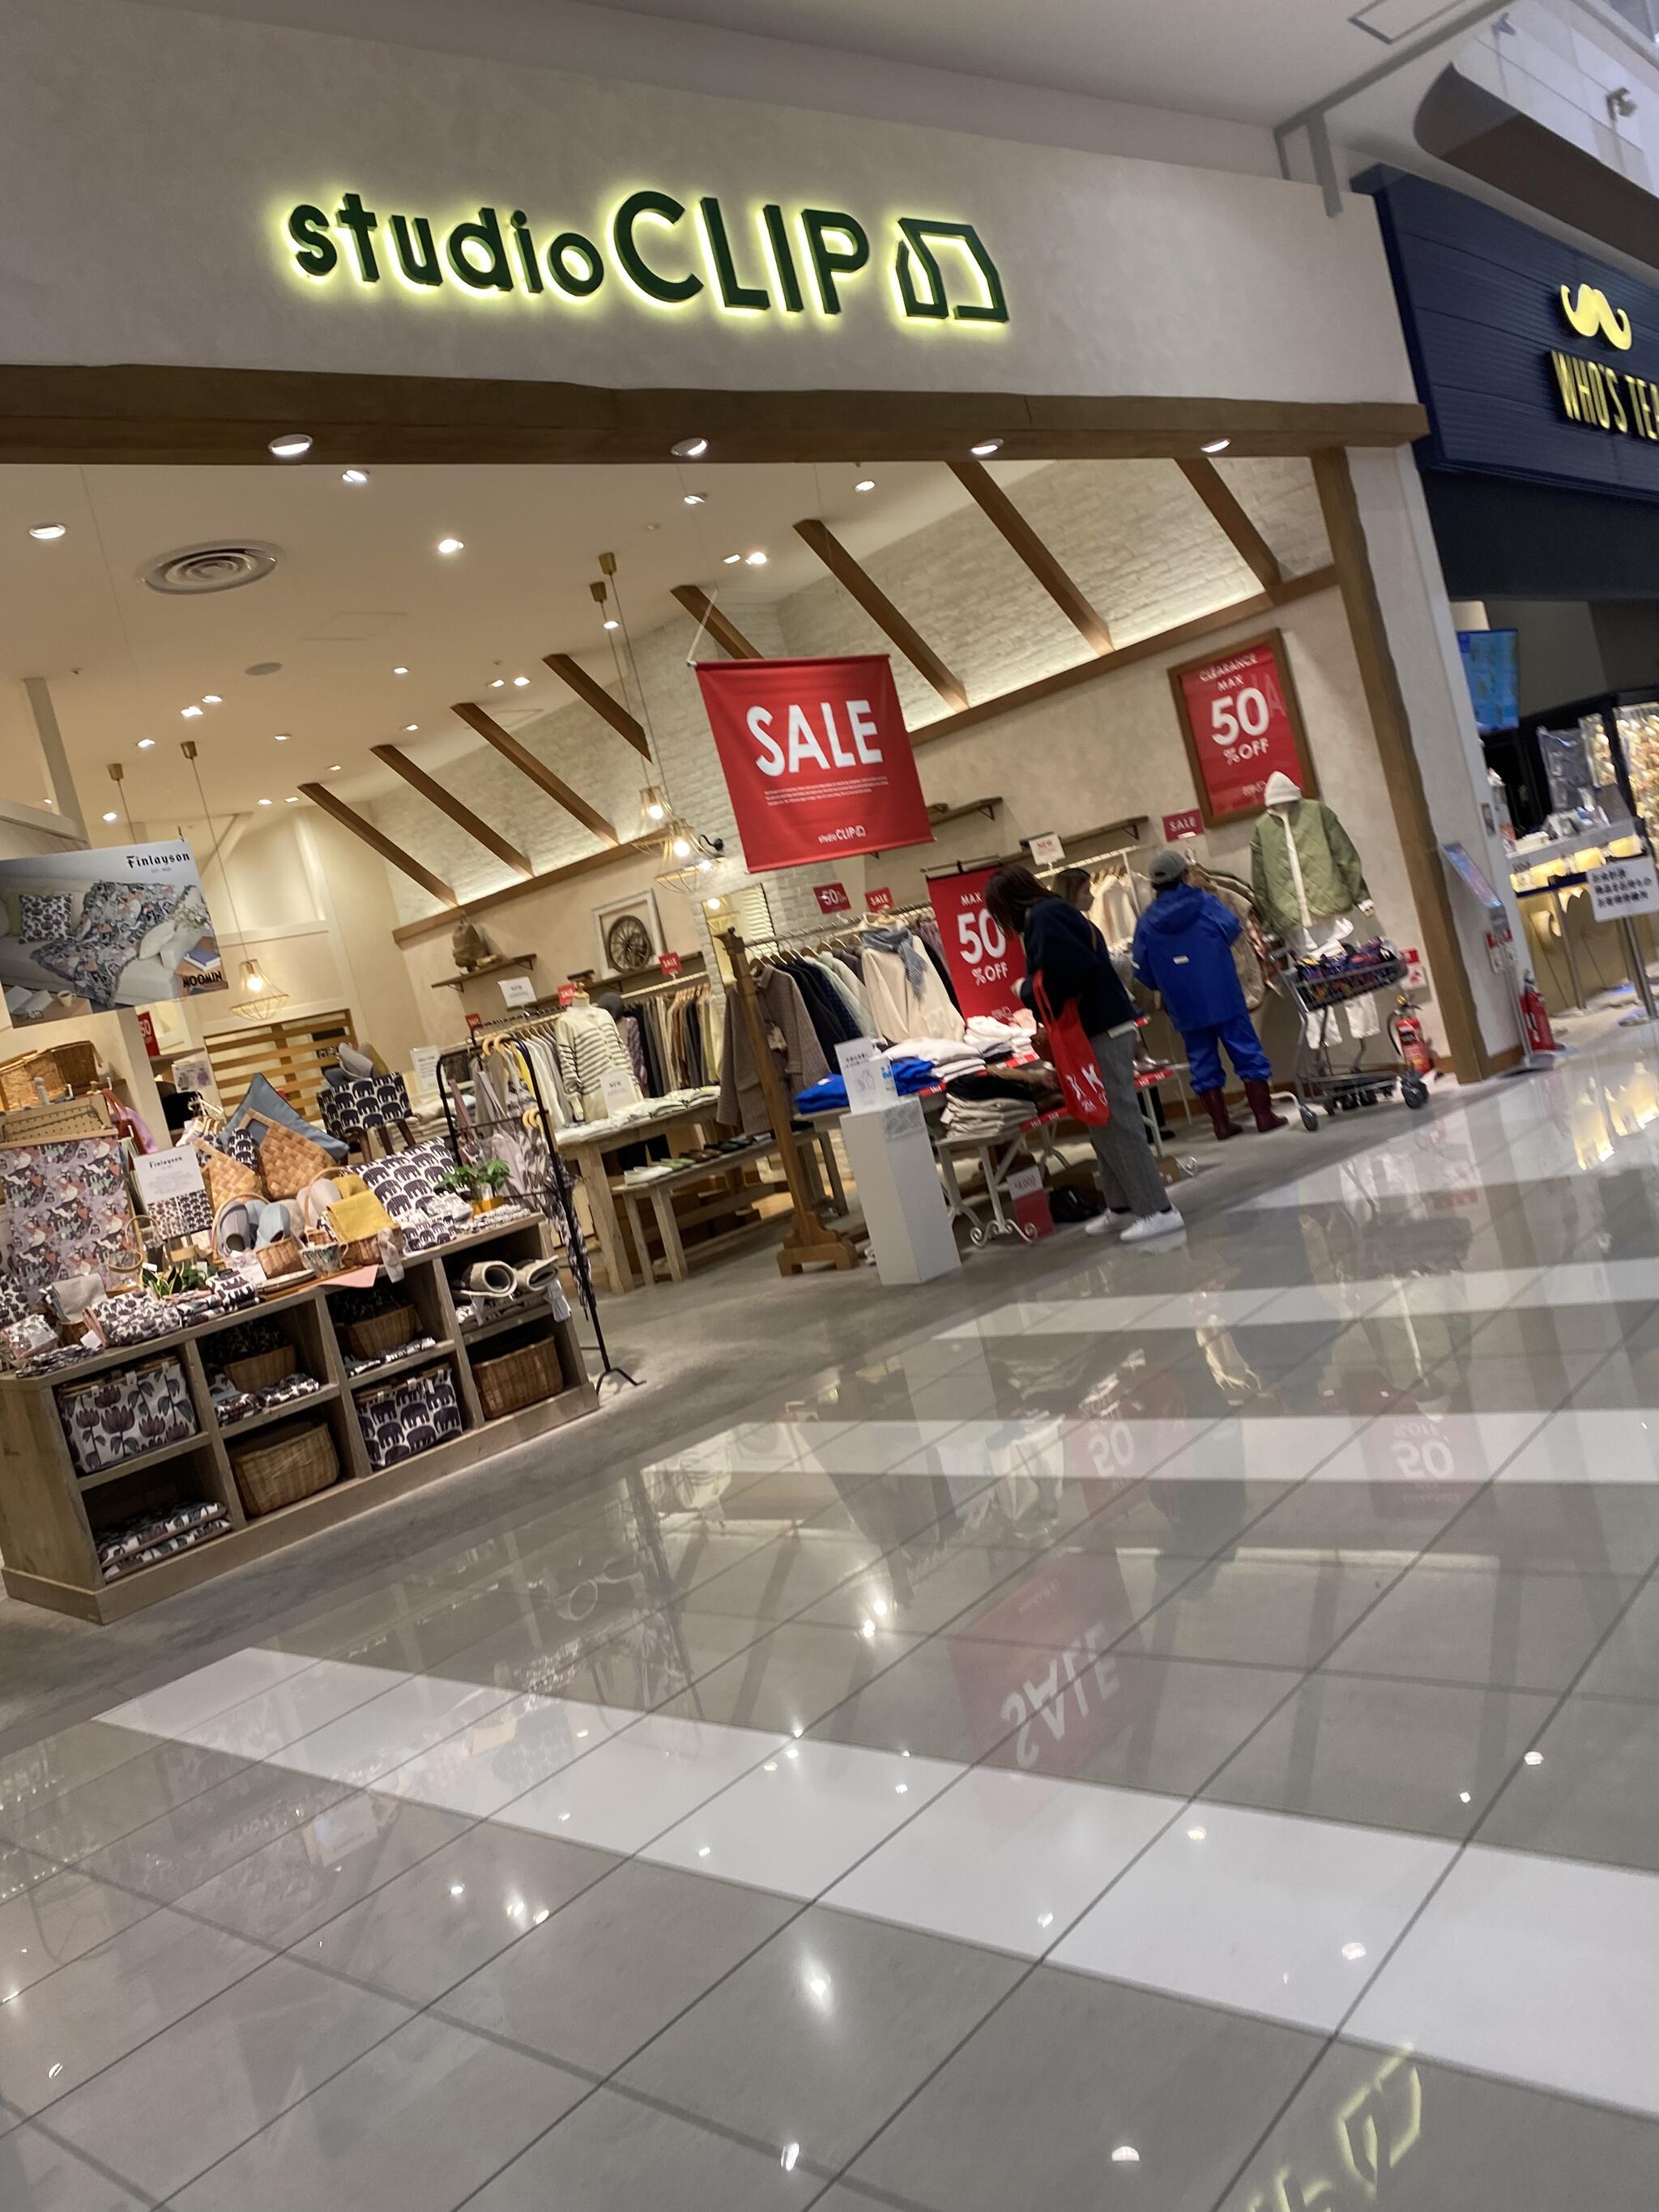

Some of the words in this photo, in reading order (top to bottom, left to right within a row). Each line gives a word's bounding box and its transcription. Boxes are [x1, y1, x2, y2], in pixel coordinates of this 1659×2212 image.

[1551, 350, 1628, 433] WHO'S
[1199, 653, 1258, 681] CLEARANCE
[1218, 674, 1244, 692] MAX
[1211, 687, 1269, 746] 50
[746, 700, 884, 777] SALE
[1223, 737, 1269, 765] %OFF
[1169, 816, 1196, 832] SALE
[126, 852, 190, 868] Finlayson
[820, 889, 838, 906] 50
[869, 893, 889, 906] SALE
[961, 892, 983, 906] MAX
[957, 908, 1006, 965] 50
[663, 957, 678, 969] SALE
[182, 971, 222, 989] MOOMIN
[972, 961, 1009, 987] %OFF
